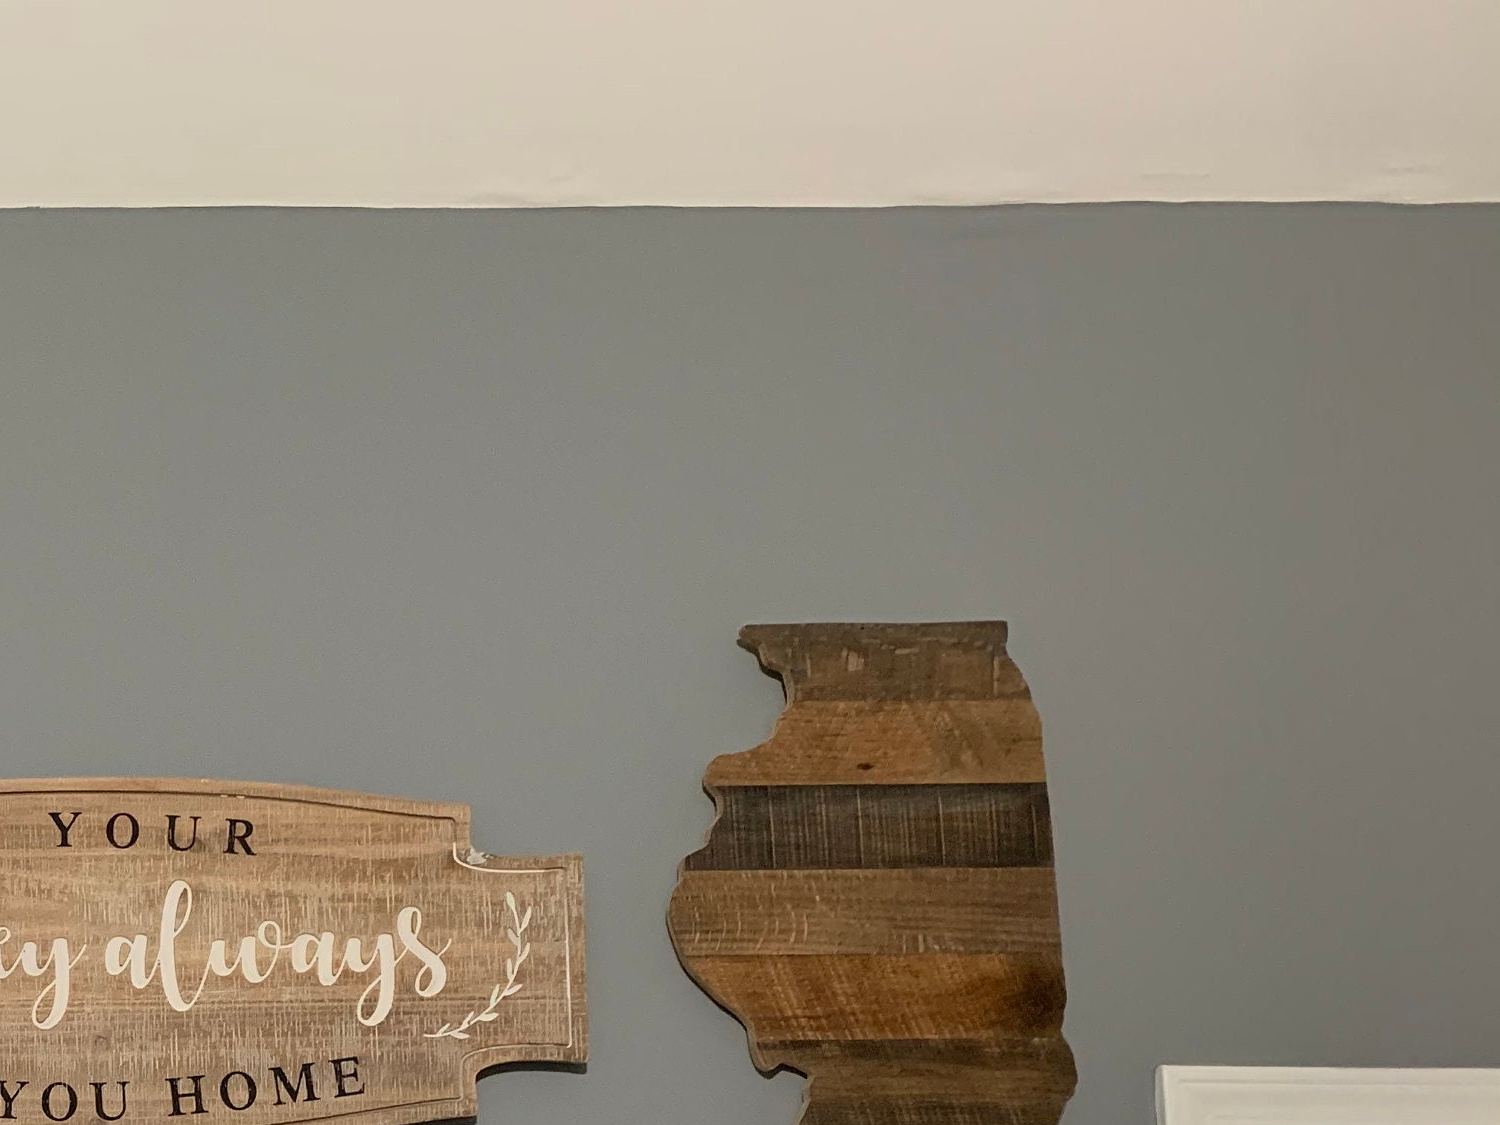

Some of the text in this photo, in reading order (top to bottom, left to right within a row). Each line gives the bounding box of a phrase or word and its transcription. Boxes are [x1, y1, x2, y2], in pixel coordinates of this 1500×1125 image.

[48, 811, 258, 856] YOUR
[105, 880, 452, 1026] always
[165, 1055, 367, 1118] HOME
